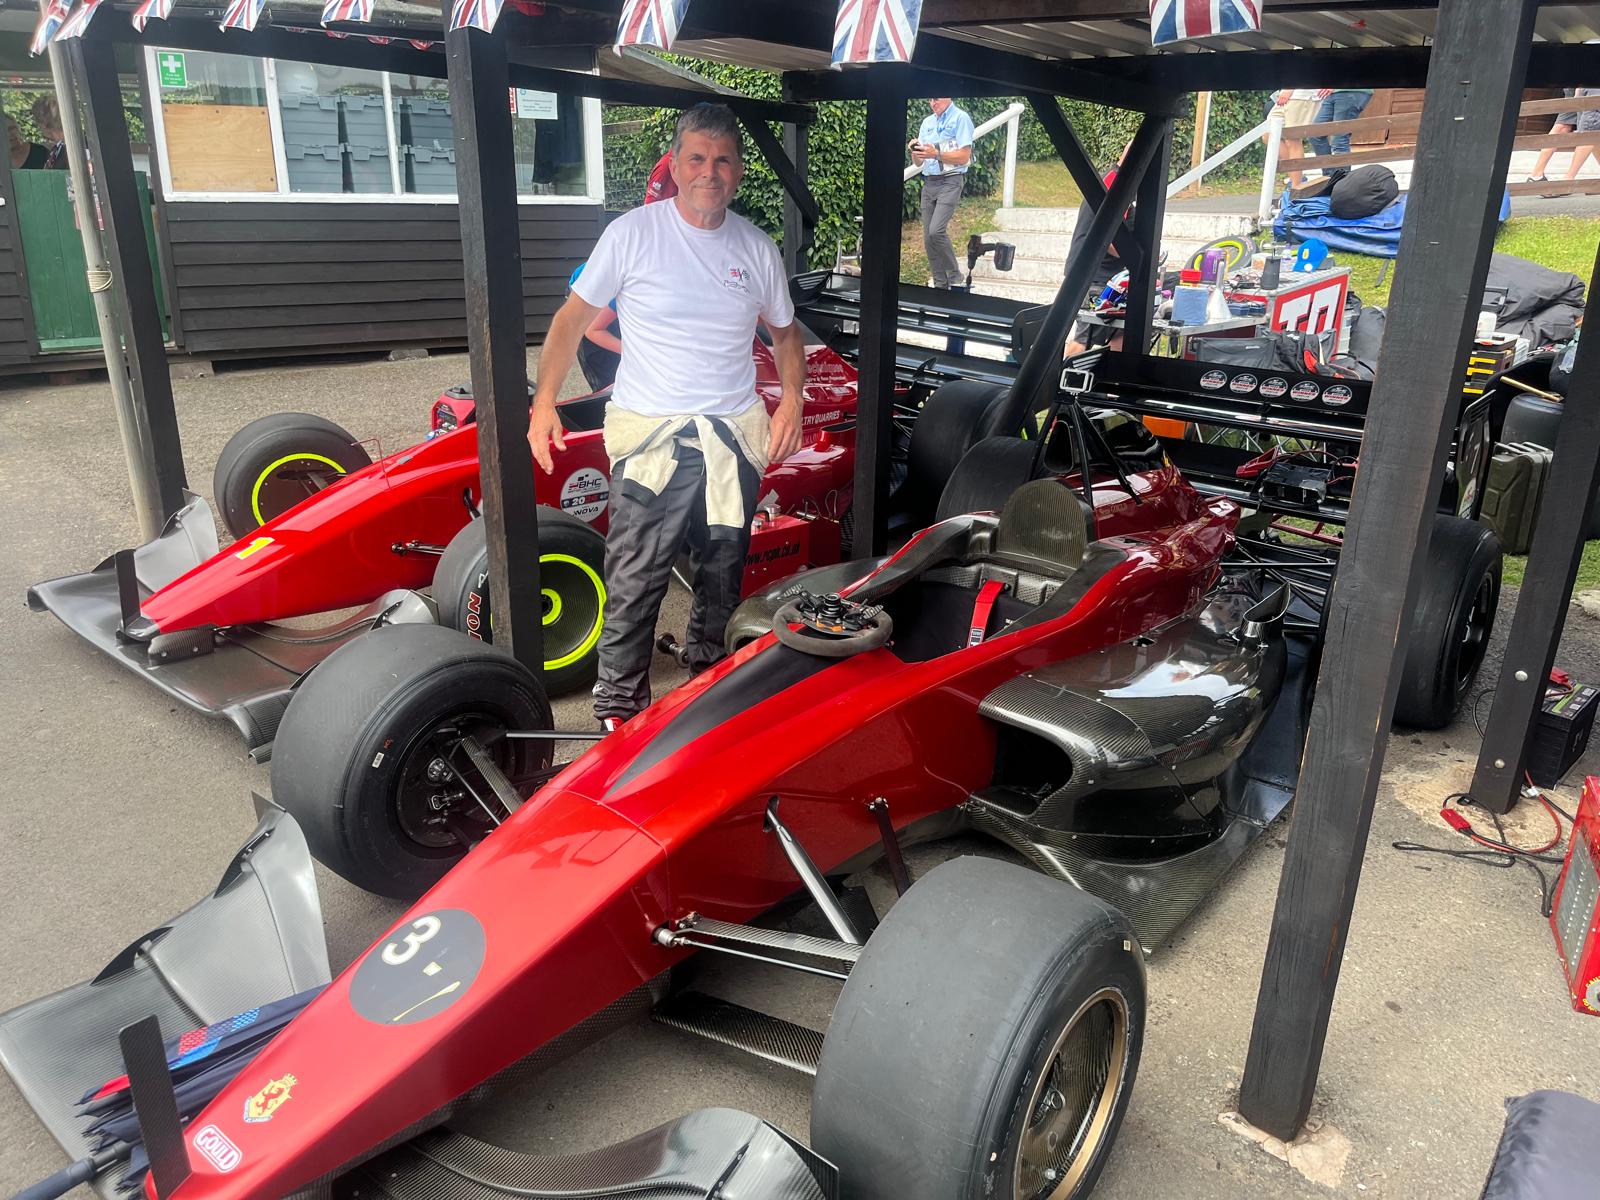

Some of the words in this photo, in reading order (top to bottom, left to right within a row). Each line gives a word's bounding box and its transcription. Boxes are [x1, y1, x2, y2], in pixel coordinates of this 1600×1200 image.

[234, 537, 276, 560] 1
[381, 915, 442, 966] 3
[196, 1127, 239, 1170] GOULD
